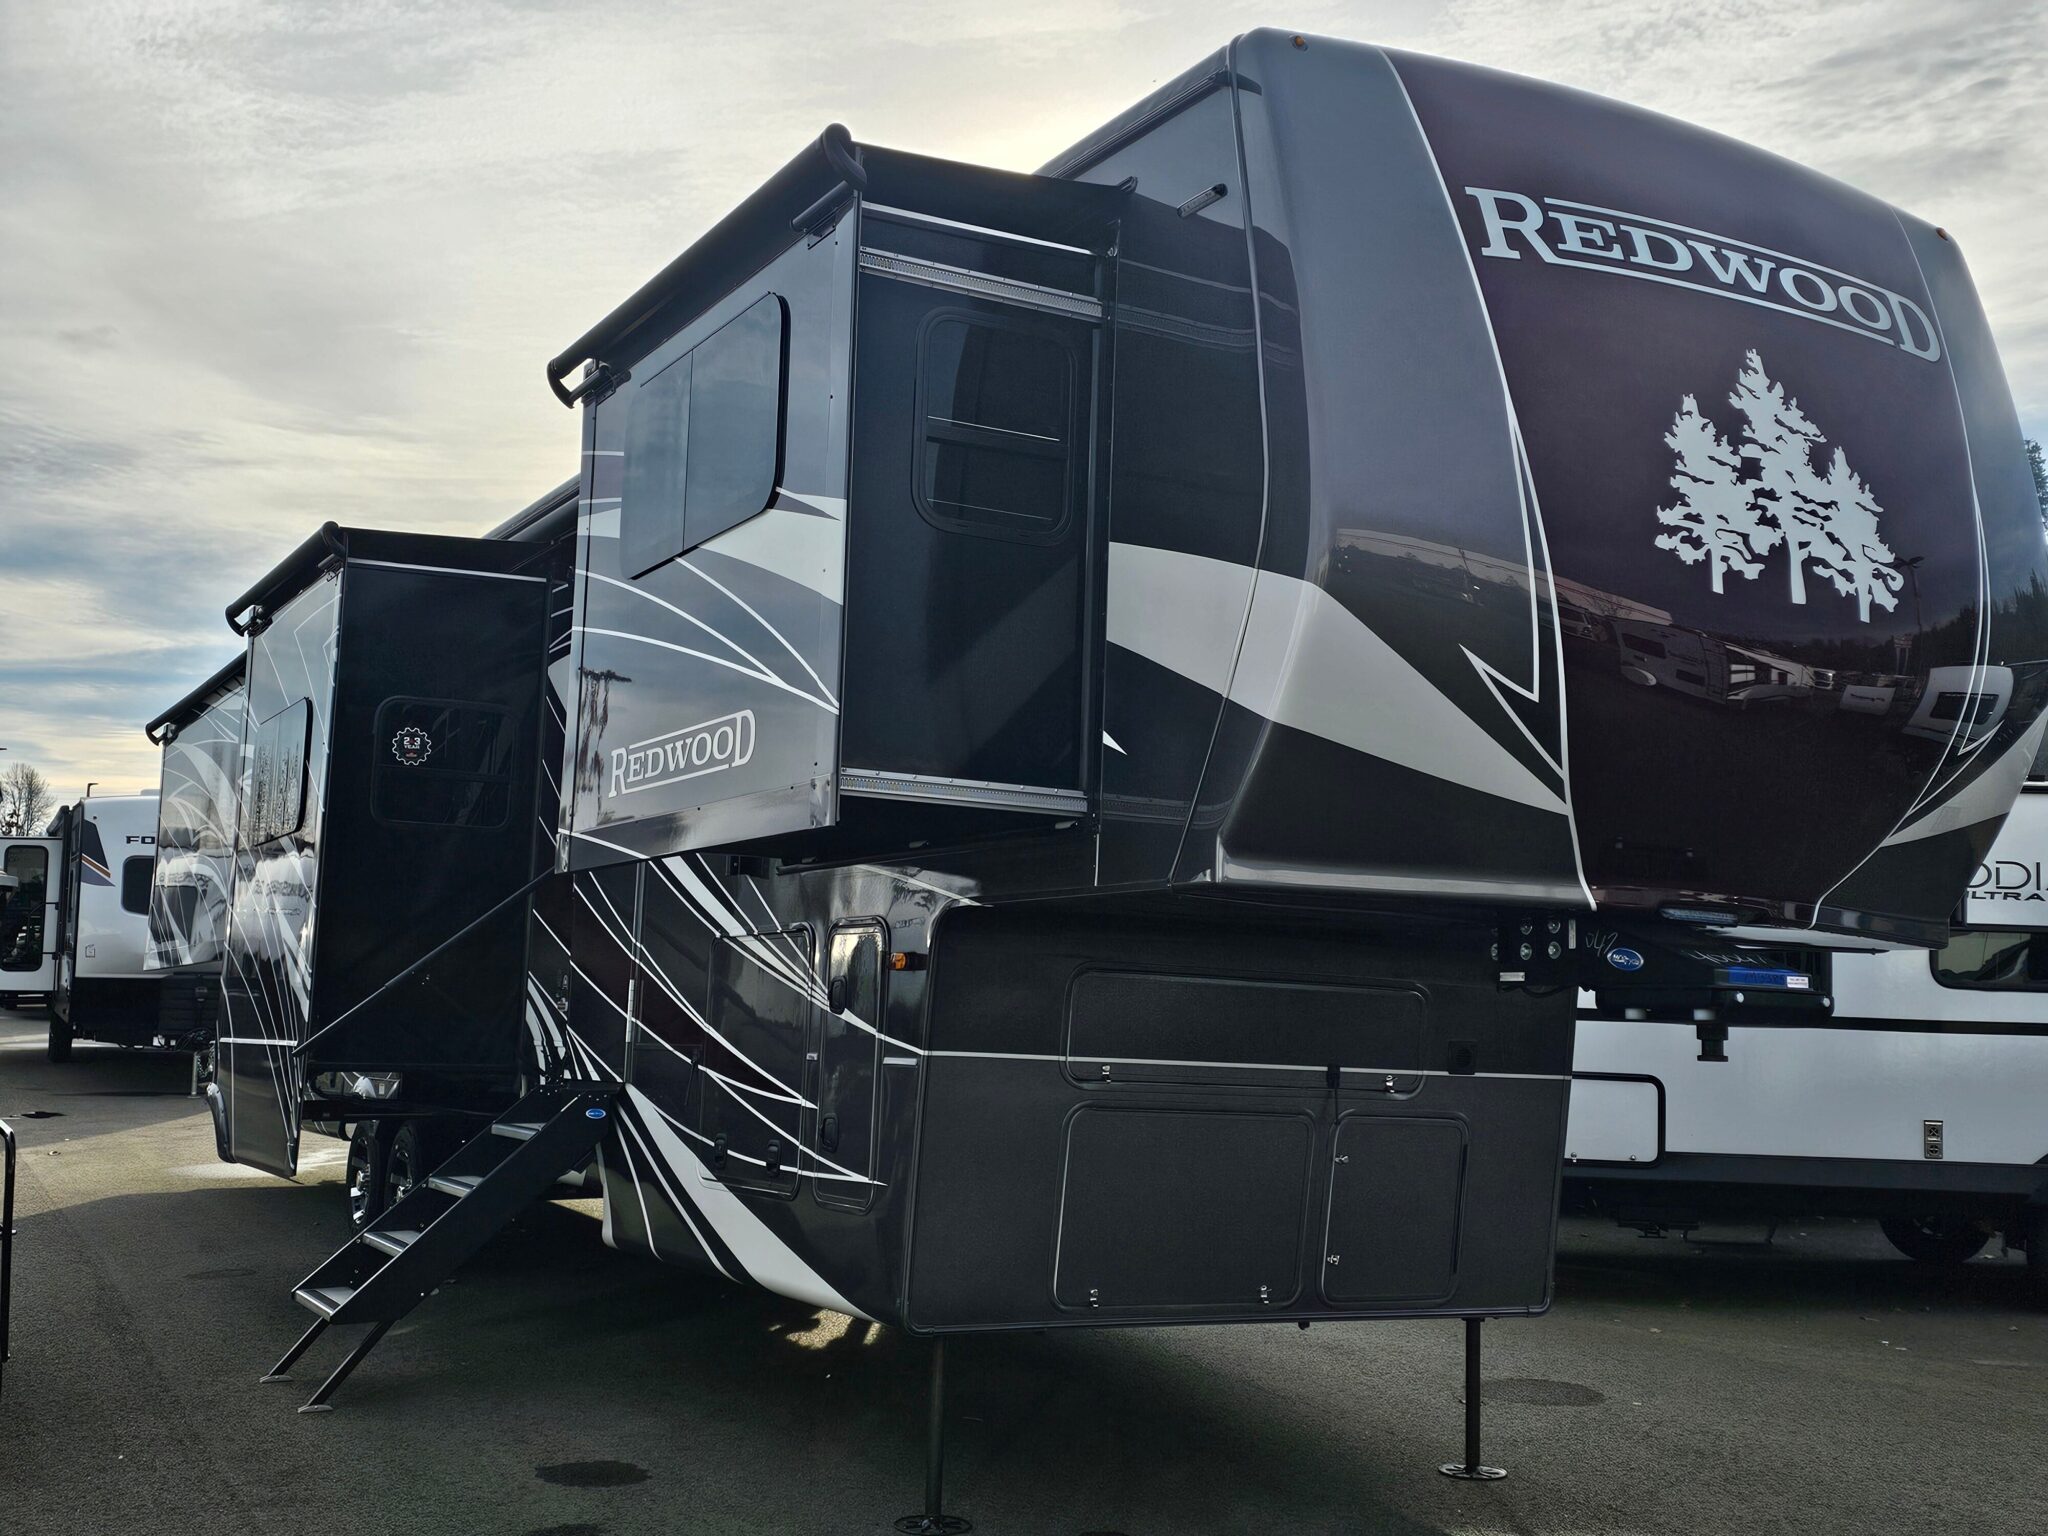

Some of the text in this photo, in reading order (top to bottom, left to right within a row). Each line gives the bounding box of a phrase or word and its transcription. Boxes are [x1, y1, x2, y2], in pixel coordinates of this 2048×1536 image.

[1465, 186, 1941, 362] REDWOOD
[608, 709, 756, 799] REDWOOD
[125, 835, 156, 845] FO
[1966, 860, 2048, 892] ODI
[1967, 890, 2047, 902] LTRA
